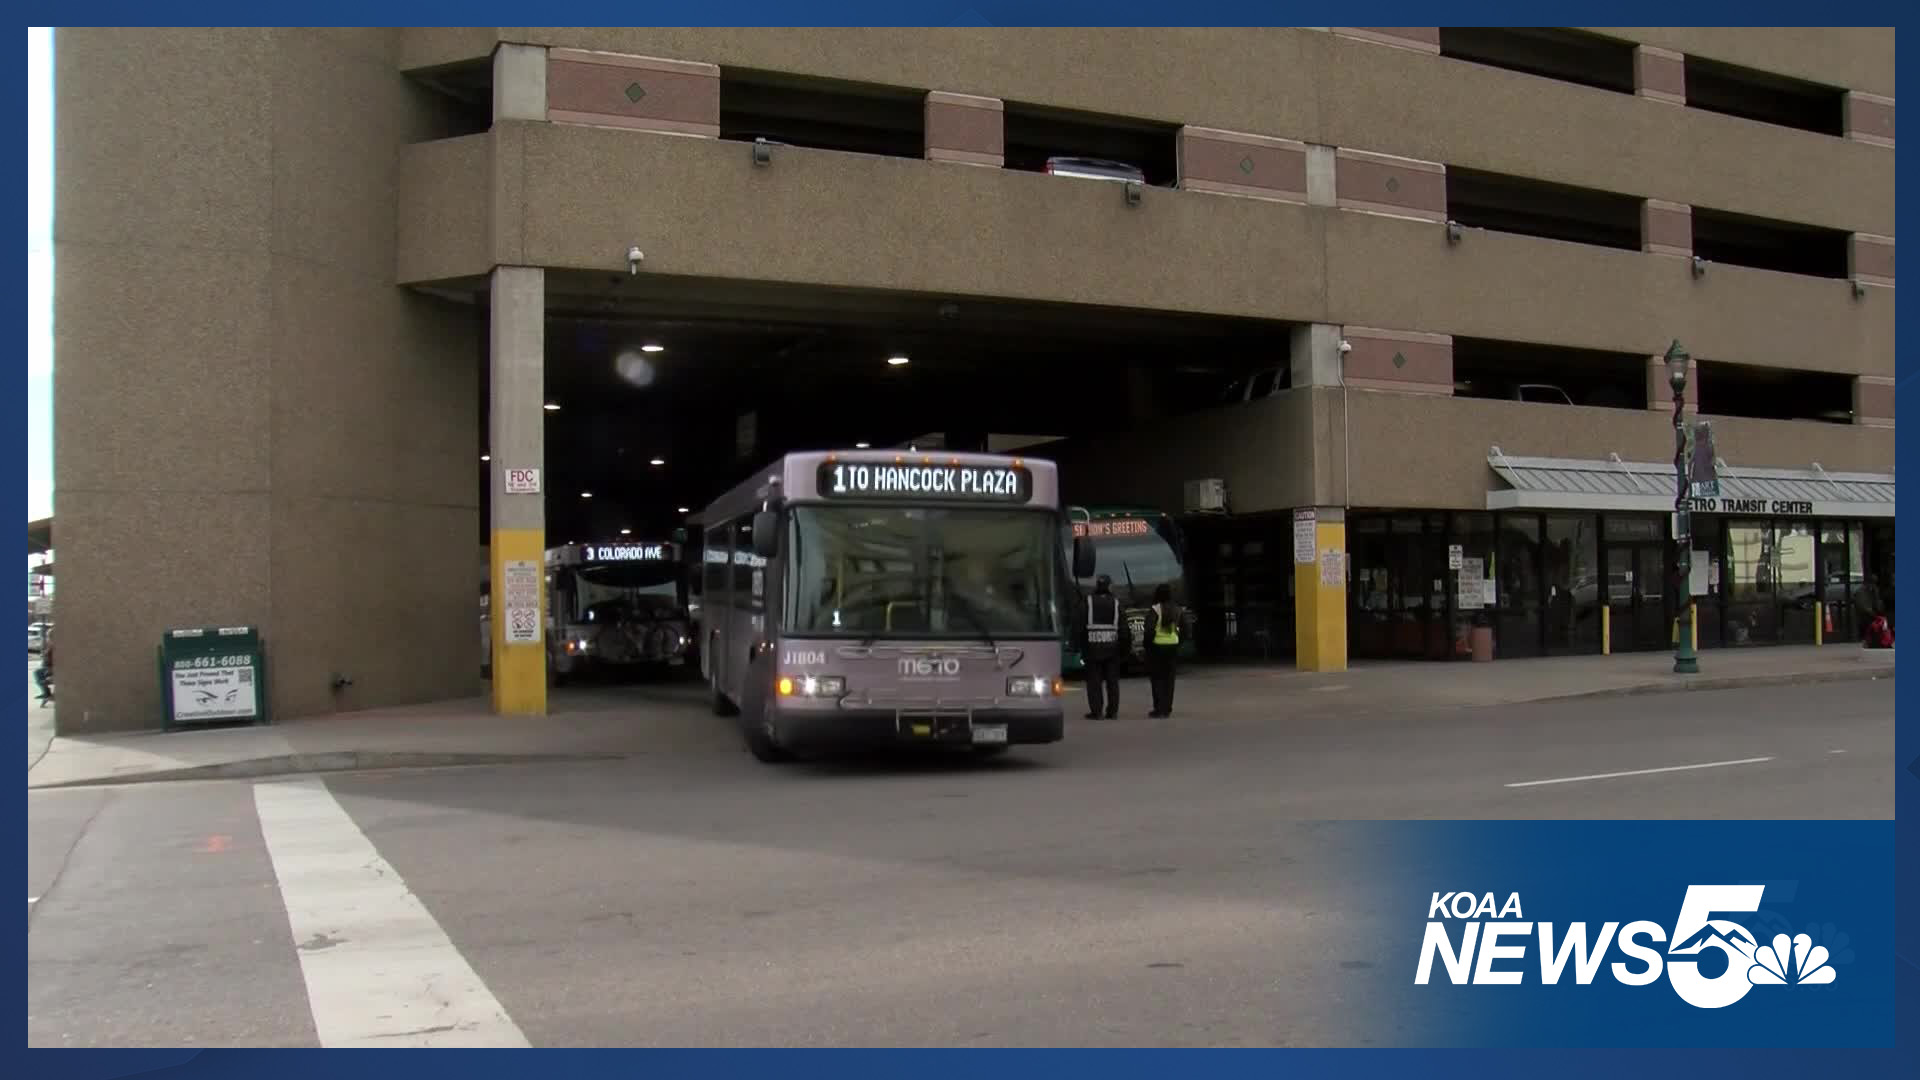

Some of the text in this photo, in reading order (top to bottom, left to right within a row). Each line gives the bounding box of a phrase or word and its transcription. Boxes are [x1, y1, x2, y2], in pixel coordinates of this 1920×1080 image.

[511, 470, 534, 481] FDC
[874, 467, 956, 493] HANCOCK
[960, 469, 1017, 495] PLAZA
[1687, 498, 1813, 514] ETRO TRANSIT CENTER
[587, 546, 662, 560] 3 COLORADO AVE
[832, 610, 841, 626] 1
